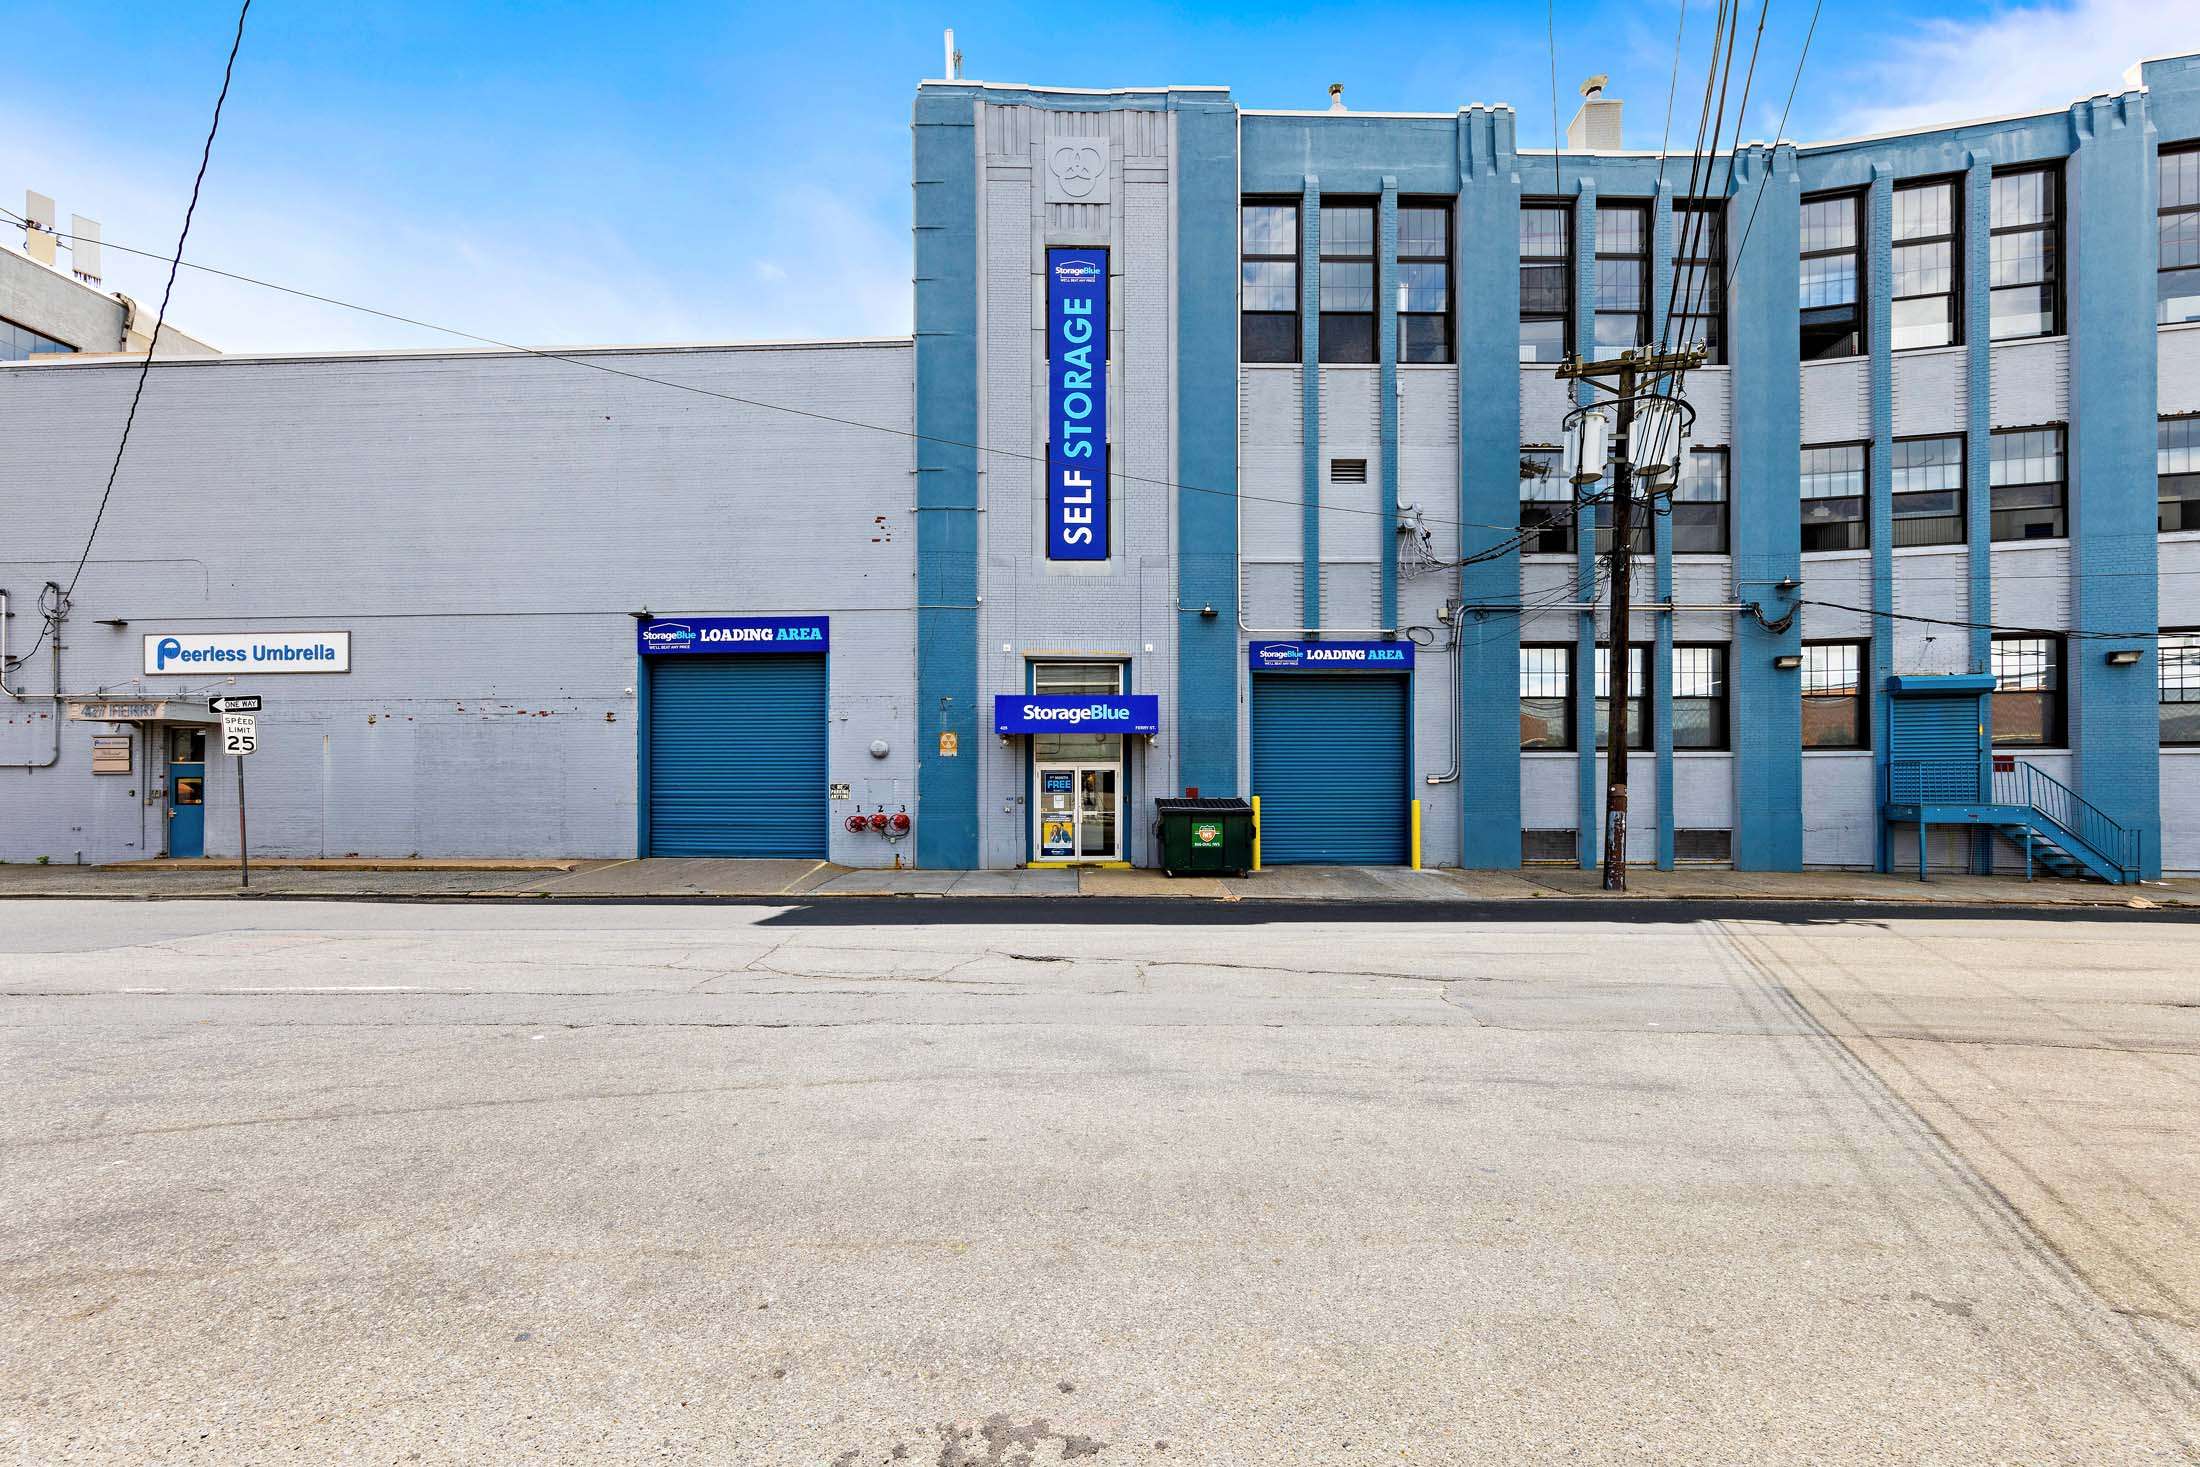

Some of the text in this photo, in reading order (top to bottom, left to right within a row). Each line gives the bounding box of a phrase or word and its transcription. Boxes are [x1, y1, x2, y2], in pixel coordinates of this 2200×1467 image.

[1056, 266, 1100, 276] StorageBlue
[1063, 299, 1092, 544] SELF STORAGE
[643, 628, 822, 642] StorageBlue LOADING AREA
[158, 638, 335, 670] Peerless Umbrella
[1259, 650, 1404, 660] StorageBlue LOADING AREA
[1023, 704, 1129, 724] StorageBlue
[228, 736, 254, 750] 25
[1048, 780, 1071, 788] FREE
